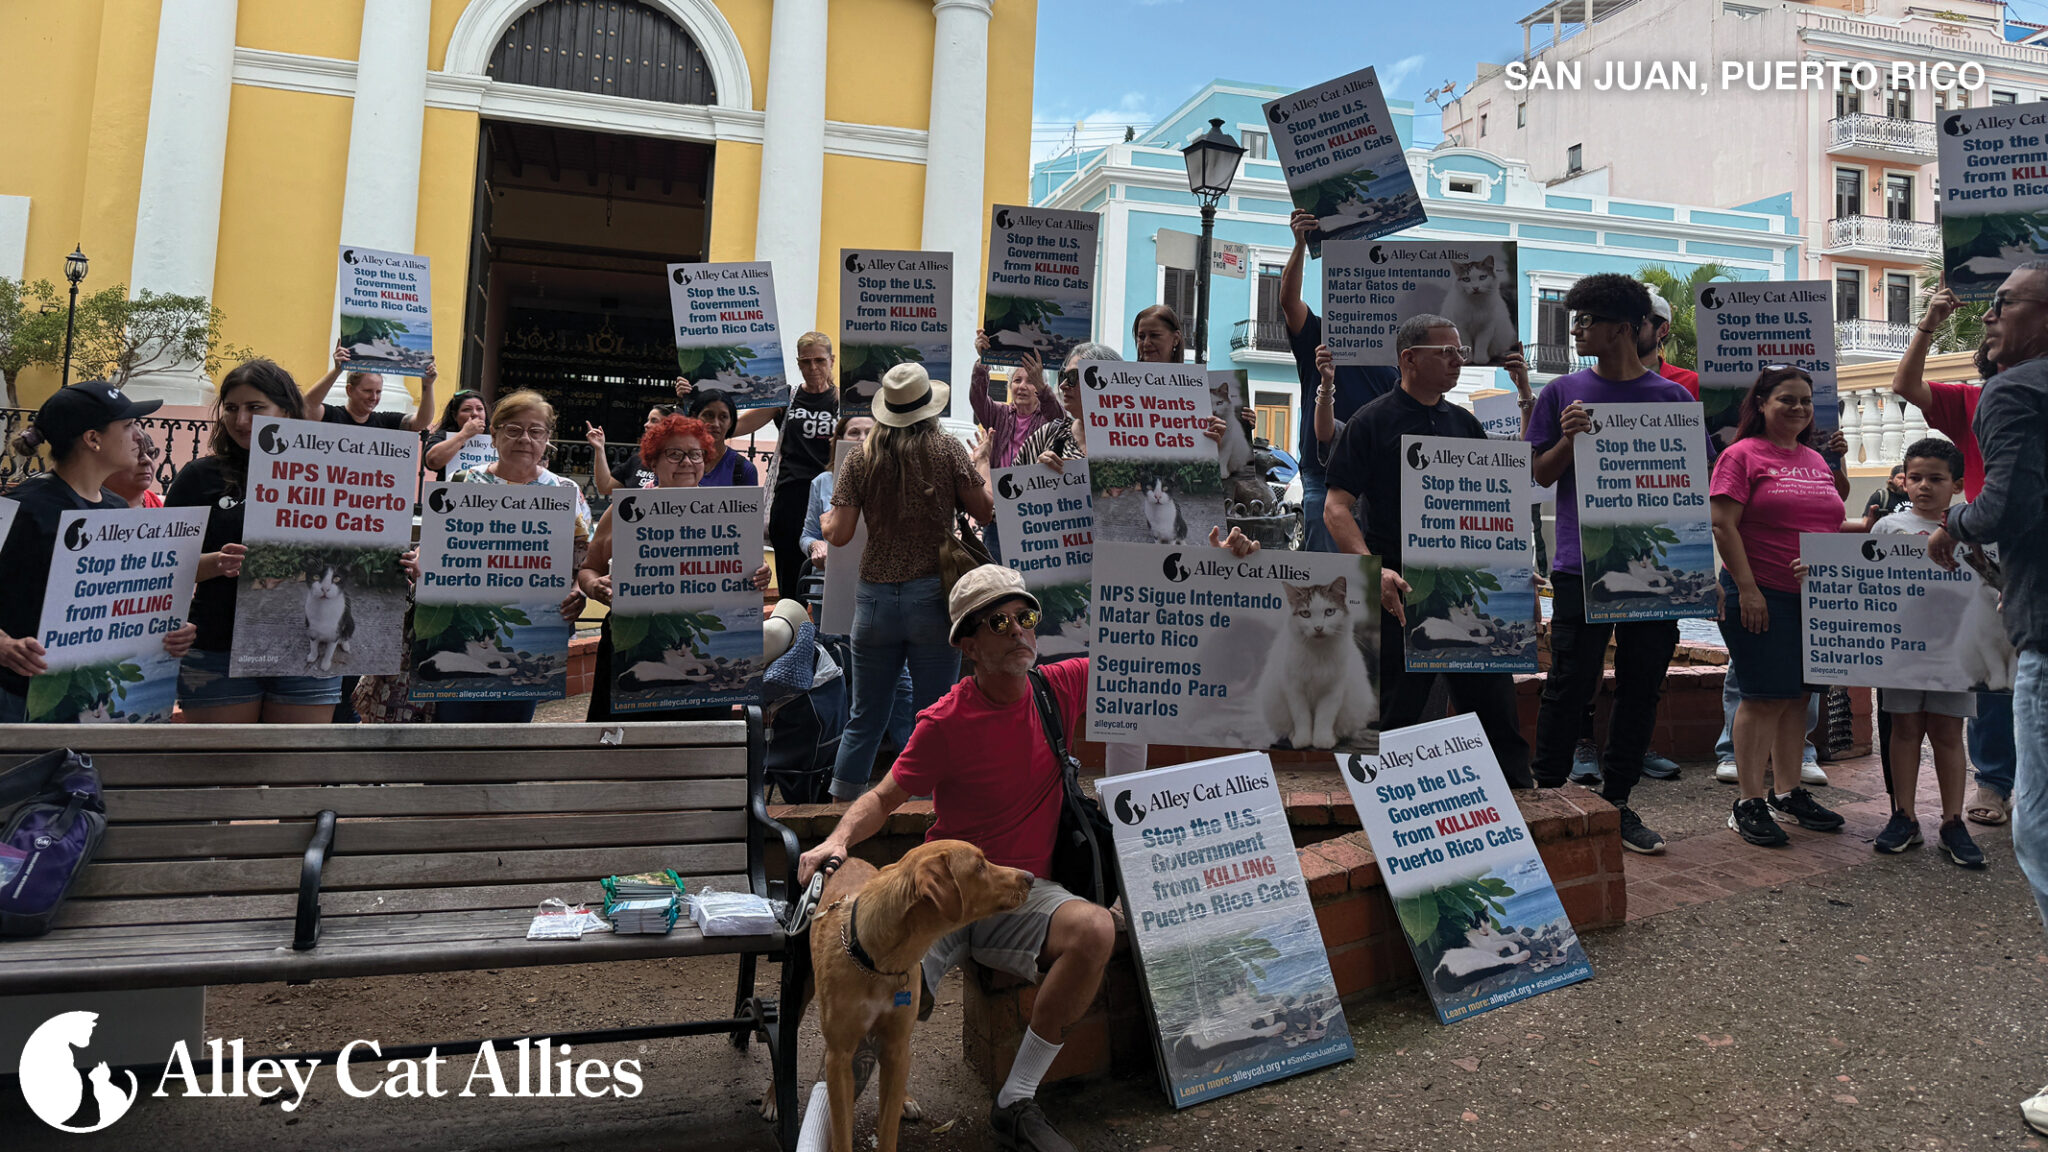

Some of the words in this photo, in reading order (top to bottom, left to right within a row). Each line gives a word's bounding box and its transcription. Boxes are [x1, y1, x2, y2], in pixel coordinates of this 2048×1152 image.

[1289, 98, 1318, 113] Alley
[1321, 89, 1340, 102] Cat
[1343, 79, 1374, 95] Allies
[1974, 116, 2015, 128] Alley
[2019, 114, 2046, 125] Cat
[1963, 139, 2003, 152] Stop
[2009, 136, 2038, 148] the
[1288, 157, 1329, 177] Puerto
[1332, 146, 1361, 162] Rico
[1364, 135, 1393, 150] Cats
[1967, 150, 2048, 168] Governm
[1963, 171, 2006, 183] from
[1948, 186, 2007, 200] Puerto
[1007, 233, 1033, 246] Stop
[1037, 236, 1055, 246] the
[1059, 237, 1079, 248] U.S.
[1008, 247, 1077, 262] Government
[1004, 259, 1031, 271] from
[1035, 262, 1078, 275] KILLING
[1329, 267, 1351, 277] NPS
[1354, 268, 1385, 279] Sigue
[1389, 268, 1450, 278] Intentando
[687, 288, 713, 298] Stop
[716, 287, 735, 296] the
[738, 286, 759, 295] U.S.
[1328, 280, 1362, 290] Matar
[1366, 280, 1398, 290] Gatos
[1402, 281, 1416, 290] de
[345, 297, 377, 308] Puerto
[381, 301, 402, 310] Rico
[406, 304, 428, 313] Cats
[690, 298, 760, 309] Government
[689, 313, 716, 322] from
[720, 310, 763, 321] KILLING
[680, 325, 718, 335] Puerto
[722, 324, 747, 333] Rico
[750, 322, 775, 332] Cats
[1099, 394, 1135, 409] NPS
[1140, 396, 1195, 411] Wants
[788, 408, 832, 421] save
[1604, 413, 1637, 429] Alley
[1640, 414, 1661, 426] Cat
[1664, 414, 1699, 426] Allies
[292, 434, 334, 454] Alley
[338, 438, 364, 454] Cat
[368, 441, 409, 458] Allies
[1596, 439, 1628, 455] Stop
[1633, 439, 1655, 452] the
[1660, 438, 1686, 452] U.S.
[460, 452, 481, 463] Stop
[1432, 449, 1464, 467] Alley
[1467, 452, 1487, 465] Cat
[1490, 453, 1524, 467] Allies
[1600, 457, 1685, 470] Government
[272, 461, 318, 482] NPS
[327, 465, 394, 488] Wants
[1597, 475, 1631, 489] from
[1636, 474, 1690, 488] KILLING
[1422, 475, 1454, 493] Stop
[1458, 477, 1481, 492] the
[1486, 478, 1511, 493] U.S.
[255, 484, 278, 503] to
[288, 486, 325, 505] Kill
[333, 489, 405, 511] Puerto
[1425, 495, 1510, 512] Government
[1586, 494, 1632, 508] Puerto
[1637, 493, 1668, 506] Rico
[1673, 492, 1704, 505] Cats
[276, 509, 327, 529] Rico
[336, 512, 384, 532] Cats
[1422, 514, 1455, 529] from
[1460, 515, 1514, 531] KILLING
[1409, 533, 1456, 548] Puerto
[1461, 535, 1492, 550] Rico
[1496, 536, 1527, 550] Cats
[76, 557, 115, 576] Stop
[120, 554, 146, 571] the
[151, 551, 178, 569] U.S.
[1194, 561, 1233, 579] Alley
[1237, 563, 1263, 578] Cat
[1266, 564, 1309, 580] Allies
[75, 574, 174, 598] Government
[1101, 585, 1134, 602] NPS
[1138, 587, 1185, 607] Sigue
[1190, 589, 1281, 609] Intentando
[67, 604, 107, 622] from
[112, 595, 173, 616] KILLING
[1100, 606, 1150, 623] Matar
[1156, 609, 1203, 626] Gatos
[1210, 612, 1230, 628] de
[46, 626, 103, 648] Puerto
[108, 622, 144, 640] Rico
[149, 616, 182, 634] Cats
[1809, 618, 1901, 633] Seguiremos
[1099, 627, 1154, 645] Puerto
[1162, 630, 1198, 647] Rico
[1810, 634, 1884, 648] Luchando
[1891, 637, 1926, 650] Para
[238, 655, 279, 663] alleycat.org
[1097, 655, 1200, 675] Seguiremos
[1409, 660, 1427, 668] Learn
[1448, 661, 1483, 669] alleycat.org
[1810, 650, 1883, 664] Salvarlos
[1097, 676, 1181, 695] Luchando
[1189, 680, 1226, 697] Para
[1096, 697, 1177, 716] Salvarlos
[1094, 720, 1137, 730] alleycat.org
[1374, 751, 1412, 770] Alley
[1416, 744, 1442, 760] Cat
[1444, 736, 1482, 755] Allies
[1146, 790, 1189, 811] Alley
[1193, 784, 1222, 801] Cat
[1226, 775, 1269, 796] Allies
[1376, 784, 1416, 803] Stop
[1417, 776, 1446, 793] the
[1447, 766, 1480, 785] U.S.
[1388, 786, 1488, 824] Government
[1142, 827, 1186, 848] Stop
[1190, 819, 1221, 838] the
[1224, 808, 1260, 830] U.S.
[1393, 826, 1435, 847] from
[1435, 807, 1500, 836] KILLING
[1152, 833, 1265, 873] Government
[1386, 848, 1444, 874] Puerto
[1445, 838, 1484, 858] Rico
[1486, 826, 1523, 847] Cats
[1153, 877, 1200, 900] from
[1203, 856, 1276, 888] KILLING
[1141, 901, 1206, 931] Puerto
[1210, 892, 1253, 914] Rico
[1257, 879, 1299, 902] Cats
[1444, 1007, 1467, 1020] Learn
[1468, 999, 1489, 1013] more:
[1490, 985, 1532, 1005] alleycat.org
[1536, 966, 1588, 988] #SaveSanJuanCats
[1179, 1084, 1205, 1098] Learn
[1207, 1075, 1232, 1090] more:
[1232, 1061, 1281, 1083] alleycat.org
[1287, 1042, 1348, 1066] #SaveSanJuanCats
